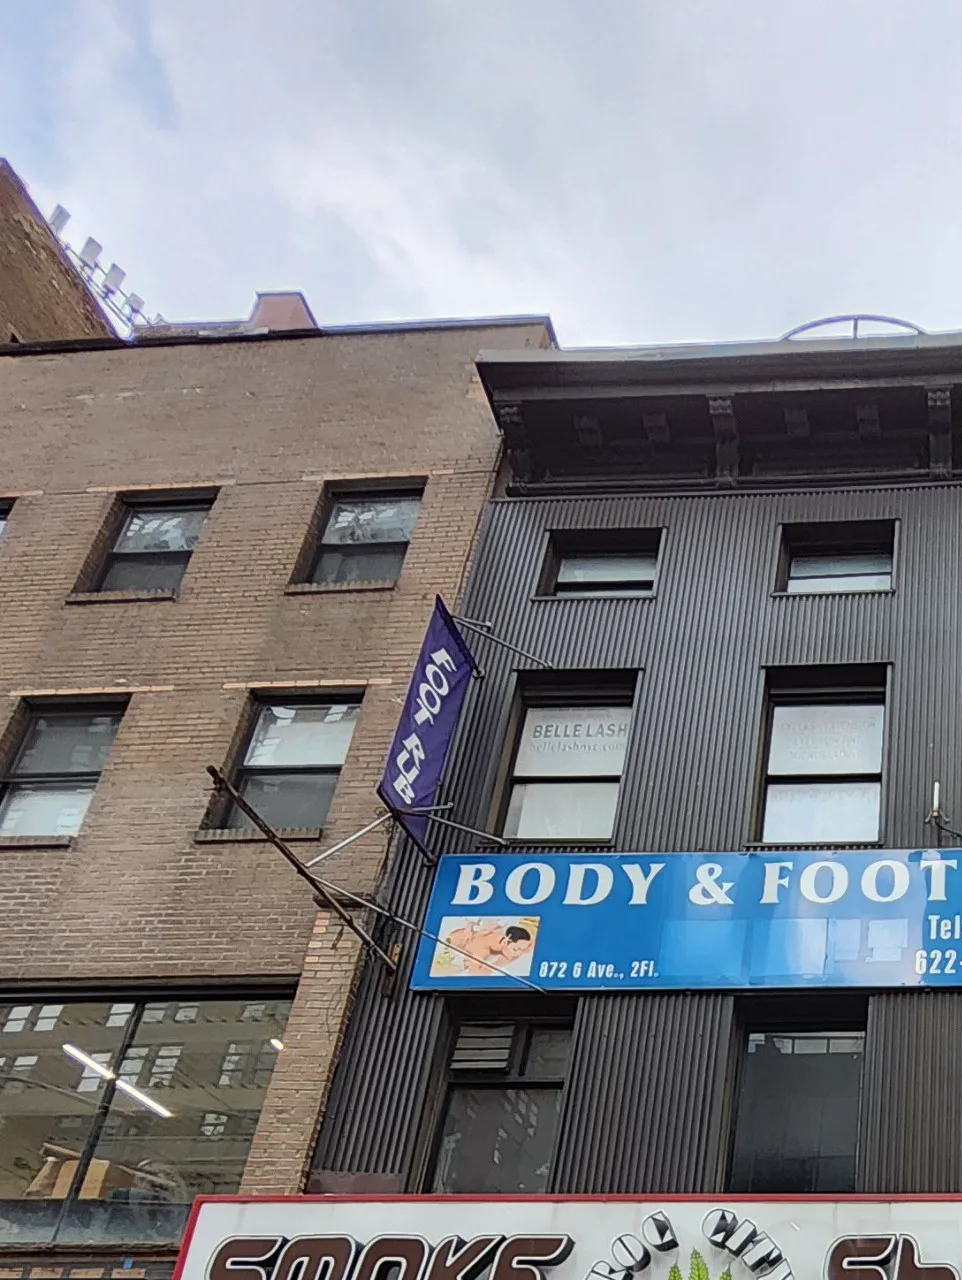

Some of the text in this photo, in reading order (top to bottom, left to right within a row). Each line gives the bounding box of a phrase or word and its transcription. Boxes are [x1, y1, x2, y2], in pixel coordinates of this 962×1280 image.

[393, 648, 457, 804] FOOT RUB
[532, 723, 628, 738] BELLE LASH
[450, 862, 666, 905] BODY
[689, 862, 735, 905] &
[760, 860, 957, 904] FOOT
[539, 961, 566, 978] 872
[572, 961, 582, 978] 6
